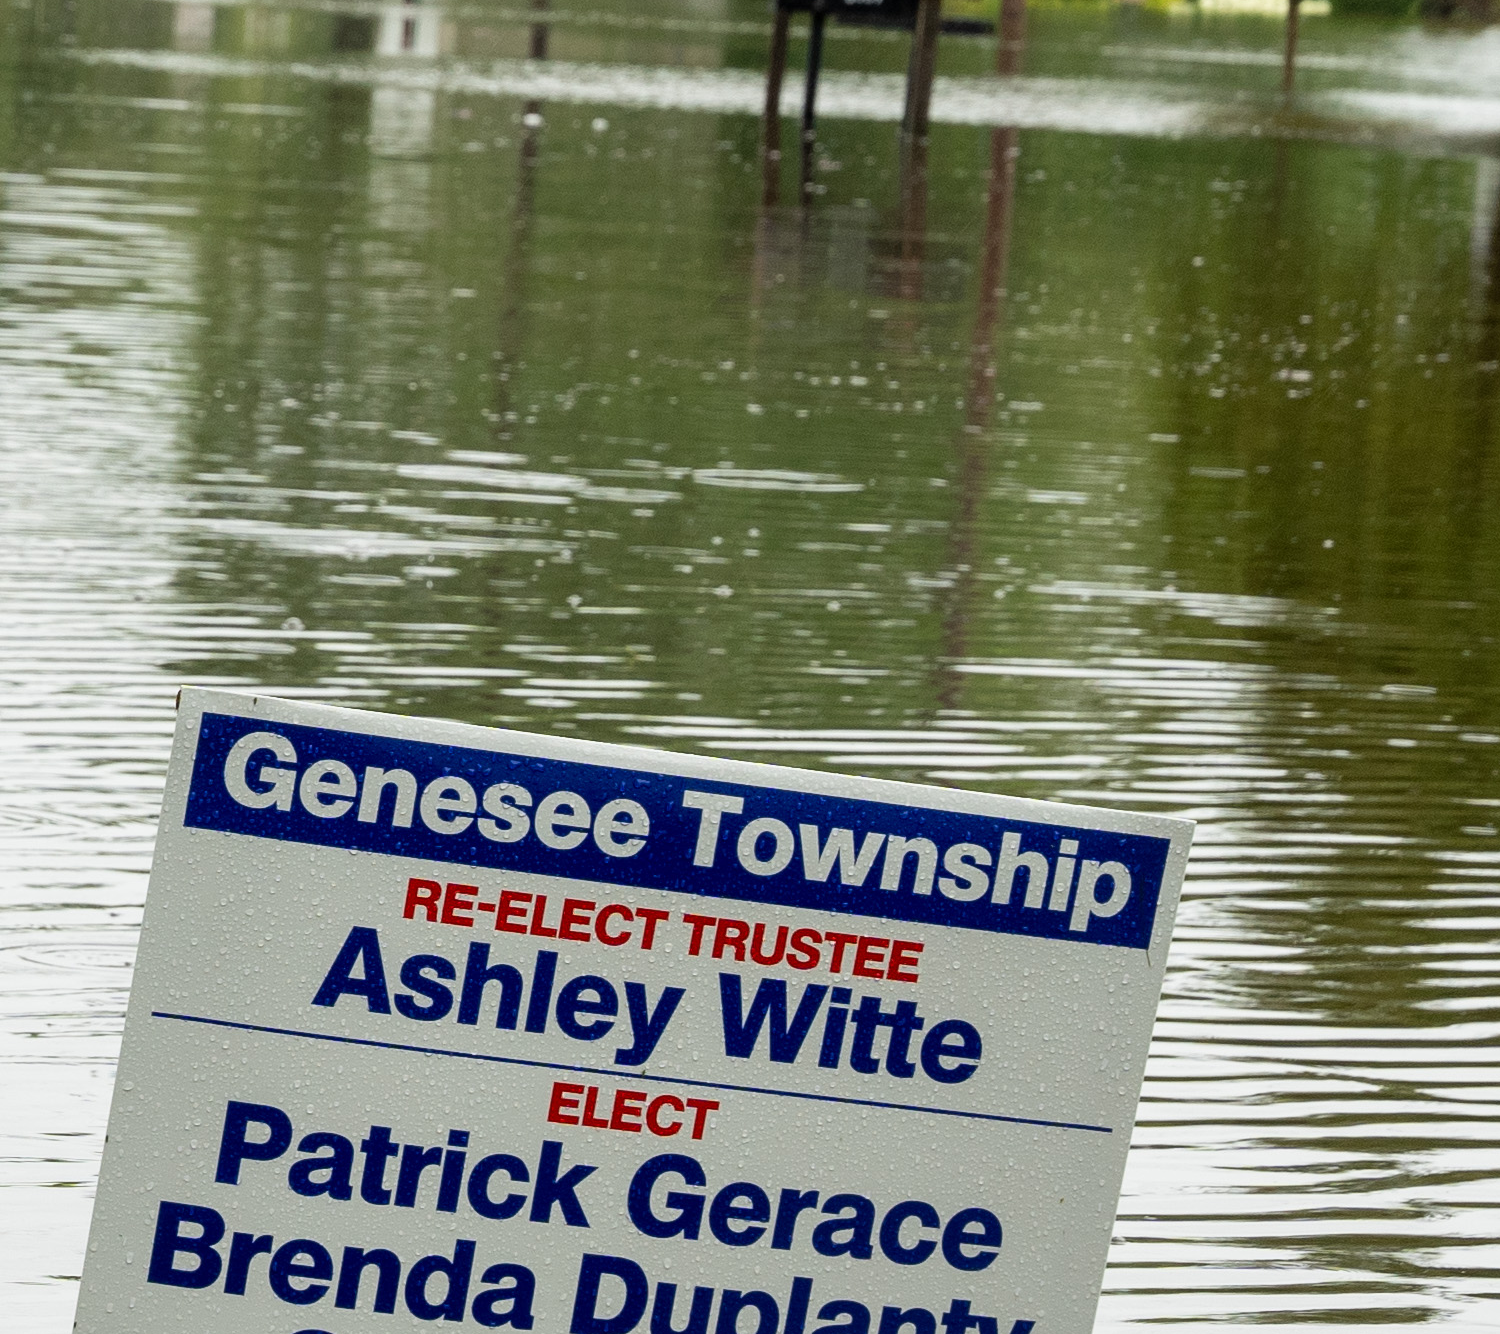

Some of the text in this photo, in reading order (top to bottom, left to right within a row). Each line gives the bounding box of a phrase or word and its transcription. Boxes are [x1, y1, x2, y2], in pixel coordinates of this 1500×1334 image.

[224, 732, 1132, 932] Genesee Township
[404, 878, 924, 984] RE-ELECT TRUSTEE
[312, 926, 982, 1084] Ashley Witte
[548, 1083, 720, 1140] ELECT
[216, 1101, 1003, 1271] Patrick Gerace
[148, 1201, 536, 1330] Brenda
